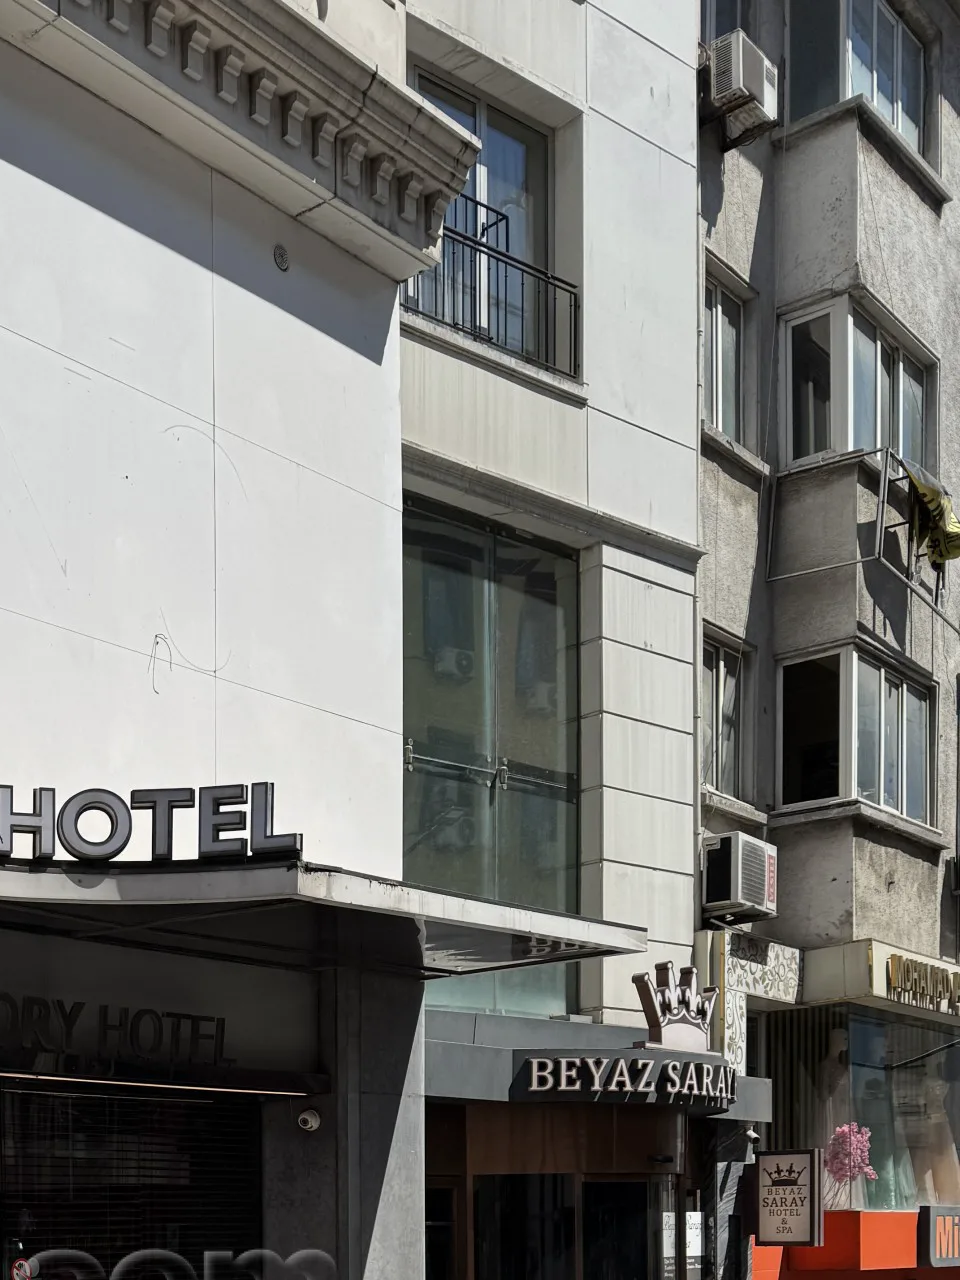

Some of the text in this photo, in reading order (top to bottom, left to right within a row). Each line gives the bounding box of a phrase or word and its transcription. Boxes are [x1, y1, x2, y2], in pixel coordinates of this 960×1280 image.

[98, 1004, 238, 1066] HOTEL
[528, 1057, 735, 1100] BEYAZ SARAY
[767, 1187, 803, 1196] BEYAZ
[762, 1196, 807, 1208] SARAY
[769, 1208, 801, 1217] HOTEL
[781, 1217, 788, 1225] &
[776, 1226, 793, 1234] SPA
